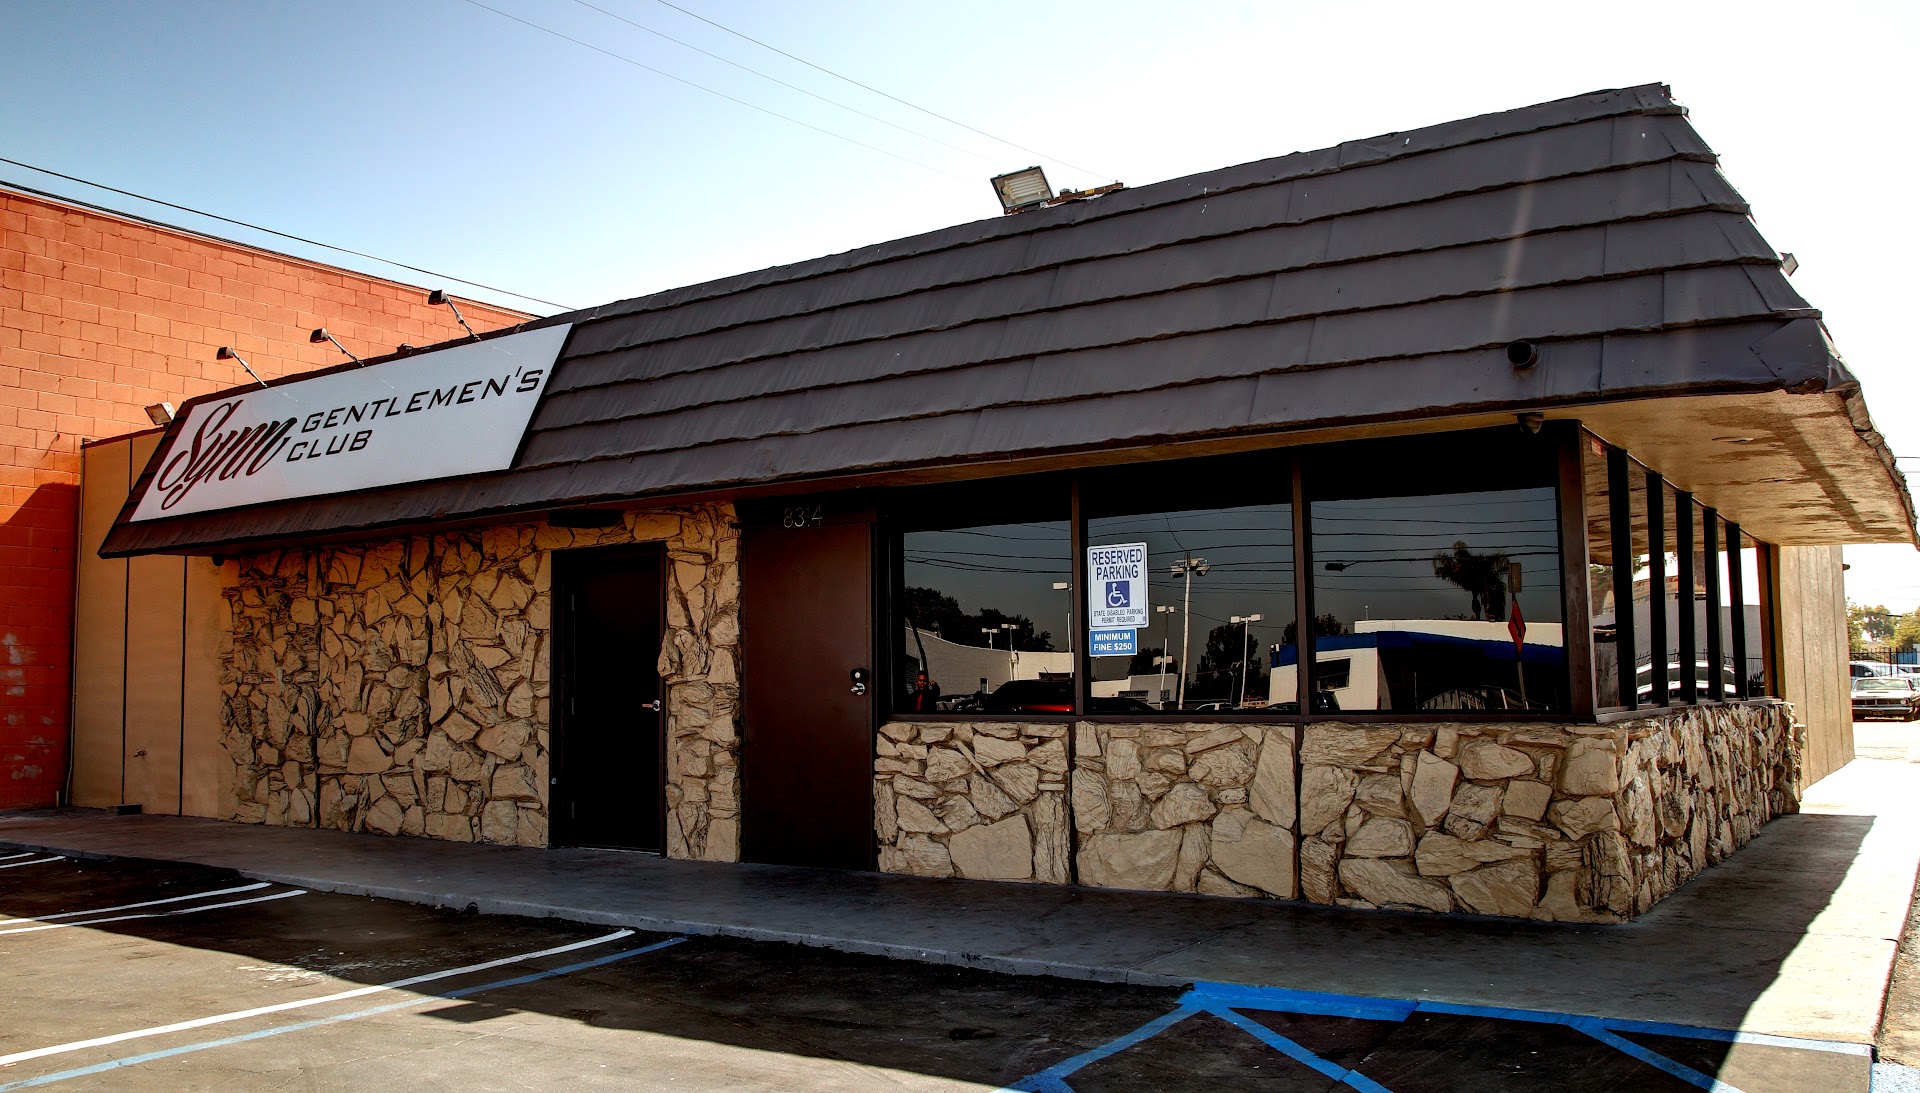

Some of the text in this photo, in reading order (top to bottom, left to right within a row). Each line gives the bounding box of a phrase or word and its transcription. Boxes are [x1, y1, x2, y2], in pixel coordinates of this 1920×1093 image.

[301, 365, 544, 433] GENTLEMEN'S
[158, 399, 297, 510] Synn
[286, 430, 373, 462] CLUB
[783, 504, 823, 529] 8314
[1092, 549, 1143, 565] RESERVED
[1096, 564, 1139, 581] PARKING
[1093, 642, 1133, 651] FINE $250
[1094, 632, 1131, 641] MINIMUM
